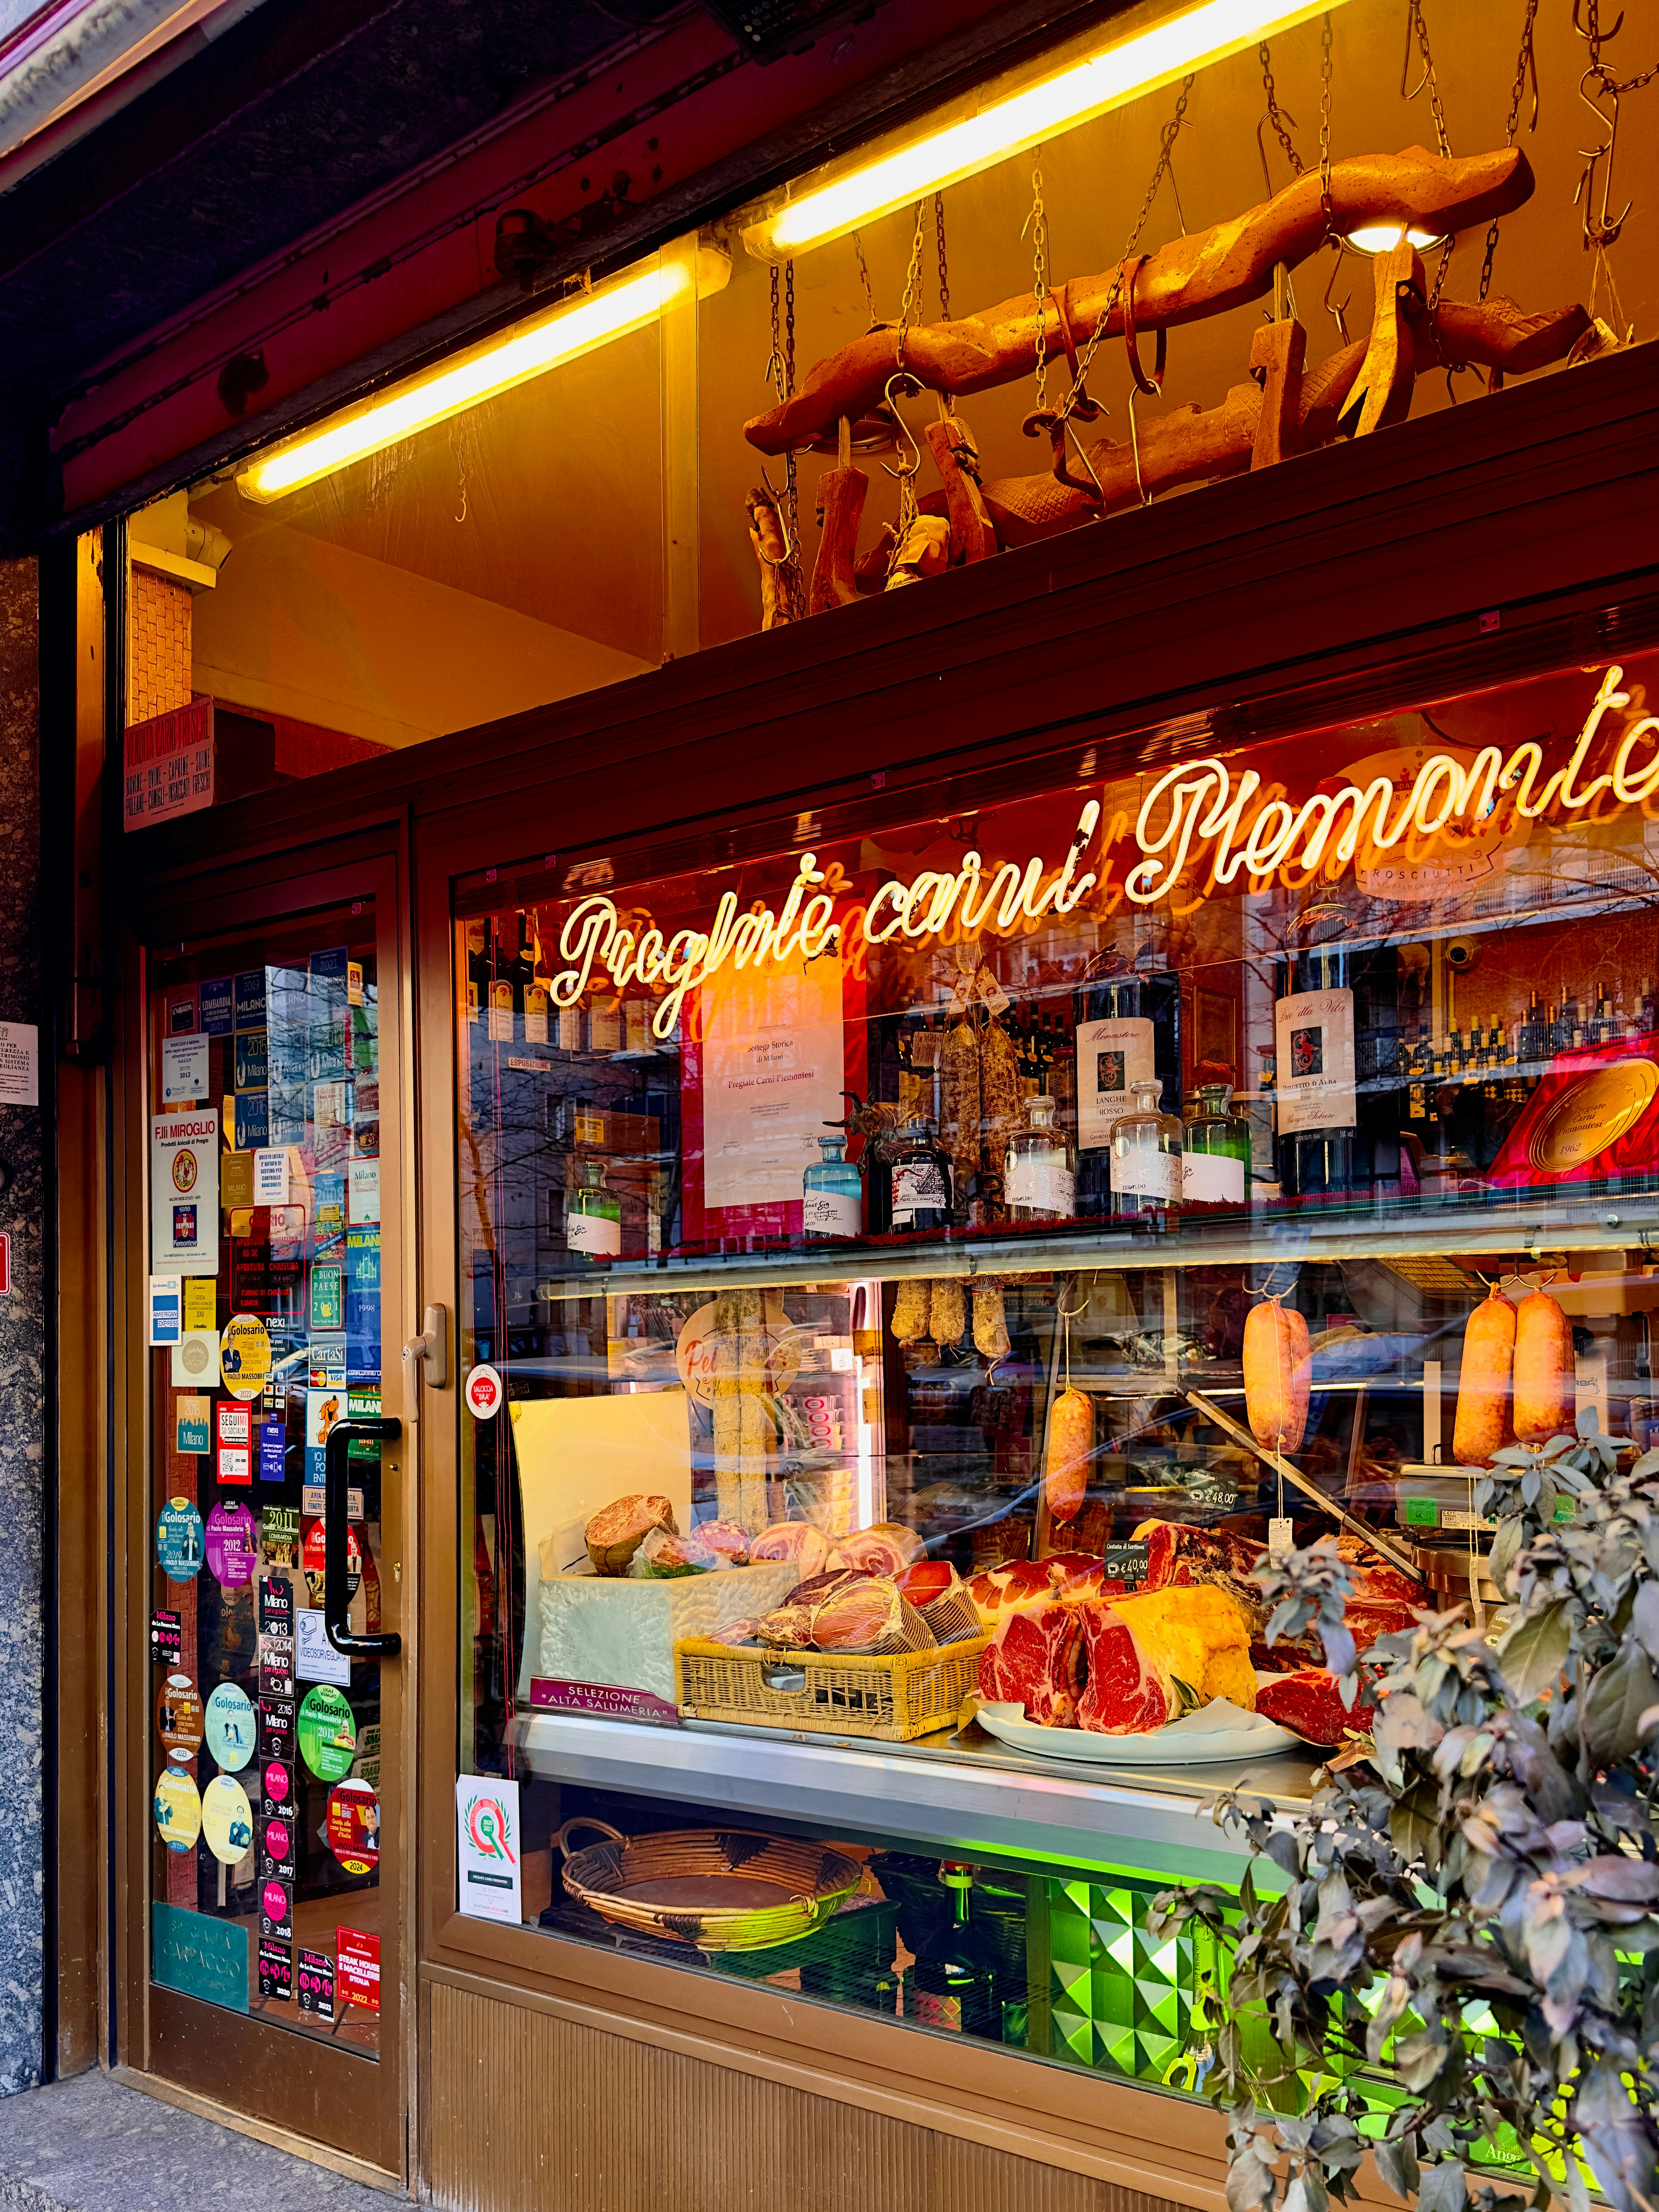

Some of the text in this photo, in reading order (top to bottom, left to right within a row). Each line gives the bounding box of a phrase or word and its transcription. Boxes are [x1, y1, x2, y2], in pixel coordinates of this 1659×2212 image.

[126, 703, 210, 767] VENDITA CARNI FRESCHE
[126, 748, 210, 796] BOVINE OVINE CAPRINE SUINE
[193, 770, 211, 795] FRESCHI
[320, 959, 337, 971] 2021
[202, 996, 231, 1011] LOMBARDIA
[275, 993, 306, 1005] MILANO
[237, 998, 266, 1013] MILANO
[1086, 1028, 1140, 1042] Monastero
[248, 1038, 267, 1056] 2015
[748, 1041, 793, 1052] Bottega Storica
[284, 1061, 304, 1073] Milano
[323, 1054, 342, 1068] Milano
[511, 1059, 548, 1069] ESPOSIZIONE
[248, 1064, 267, 1077] Milano
[728, 1070, 814, 1089] Pregiate Carni Piemontesi
[1283, 1082, 1310, 1092] DOLCETTO
[1097, 1096, 1126, 1104] LANGHE
[248, 1098, 267, 1116] 2016
[1307, 1110, 1335, 1120] Sobrero
[1573, 1112, 1596, 1123] Carni
[170, 1120, 215, 1138] MIROGLIO
[248, 1125, 267, 1137] Milano
[283, 1121, 304, 1134] Milano
[1558, 1120, 1604, 1136] Piemontesi
[1559, 1143, 1581, 1154] 1962
[355, 1171, 376, 1180] Milano
[1184, 1166, 1193, 1179] Gin
[236, 1237, 264, 1246] APERTURA
[236, 1262, 298, 1272] APERTURA CHIUSURA
[319, 1269, 338, 1279] BUON
[314, 1282, 339, 1291] PAESE
[266, 1317, 285, 1327] nexi
[222, 1415, 247, 1426] SEGUIMI
[183, 1431, 204, 1445] Milano
[314, 1452, 322, 1461] IO
[1193, 1471, 1216, 1482] Fiorentina
[1212, 1491, 1234, 1504] 48,00
[162, 1511, 200, 1524] ilGolosario
[211, 1513, 251, 1525] ilGolosario
[270, 1511, 292, 1528] 2011
[224, 1539, 241, 1552] 2012
[166, 1550, 183, 1560] 2019
[1127, 1559, 1148, 1574] 40,00
[264, 1594, 288, 1608] Milano
[156, 1611, 176, 1621] Milano
[276, 1639, 292, 1652] 2014
[264, 1652, 289, 1668] Milano
[299, 1646, 348, 1662] VIDEOSORVEGLIATA
[165, 1687, 197, 1700] ilGolosario
[568, 1686, 640, 1704] SELEZIONE
[212, 1695, 251, 1711] ilGolosario
[307, 1697, 350, 1719] ilGolosario
[542, 1693, 667, 1718] "ALTA SALUMERIA"
[278, 1704, 292, 1715] 2015
[265, 1714, 288, 1729] Milano
[318, 1713, 342, 1724] Massobrio
[318, 1726, 335, 1739] 2013
[266, 1773, 288, 1784] MILANO
[269, 1785, 286, 1795] GOLOSO
[278, 1805, 293, 1816] 2016
[267, 1831, 288, 1842] MILANO
[278, 1865, 294, 1877] 2017
[350, 1862, 363, 1872] 2024
[264, 1891, 286, 1905] MILANO
[276, 1926, 291, 1938] 2018
[264, 1941, 286, 1955] Milano
[304, 1952, 328, 1967] Milano
[338, 1954, 358, 1966] STEAK
[276, 1987, 290, 1997] 2020
[351, 1992, 368, 2004] 2022
[318, 2002, 332, 2011] 2021
